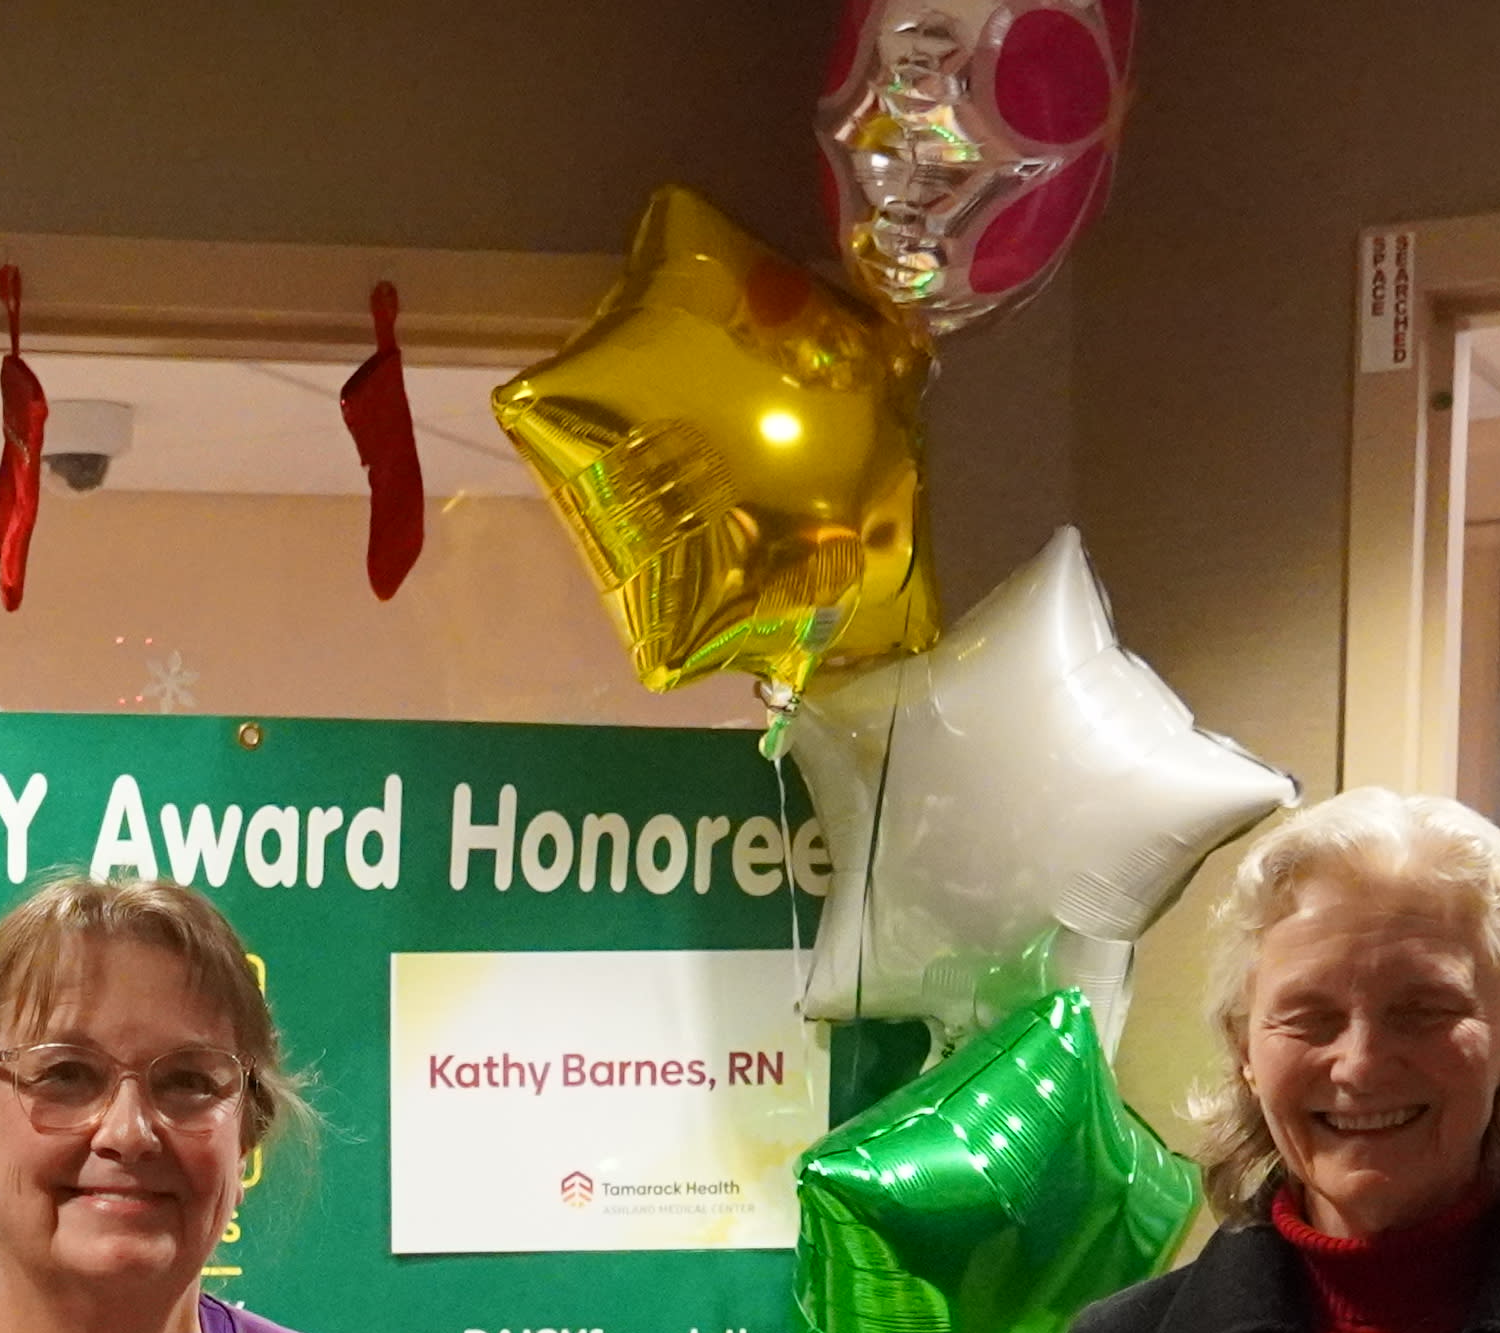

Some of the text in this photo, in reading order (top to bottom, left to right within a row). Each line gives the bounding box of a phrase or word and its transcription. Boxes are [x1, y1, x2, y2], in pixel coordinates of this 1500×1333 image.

[1371, 238, 1385, 316] SPACE
[1394, 235, 1408, 363] SEARCHED
[90, 774, 402, 889] Award
[430, 1052, 784, 1096] Kathy Barnes, RN
[602, 1180, 740, 1196] Tamarack Health
[659, 1205, 706, 1214] MEDICAL
[712, 1204, 755, 1213] CENTER
